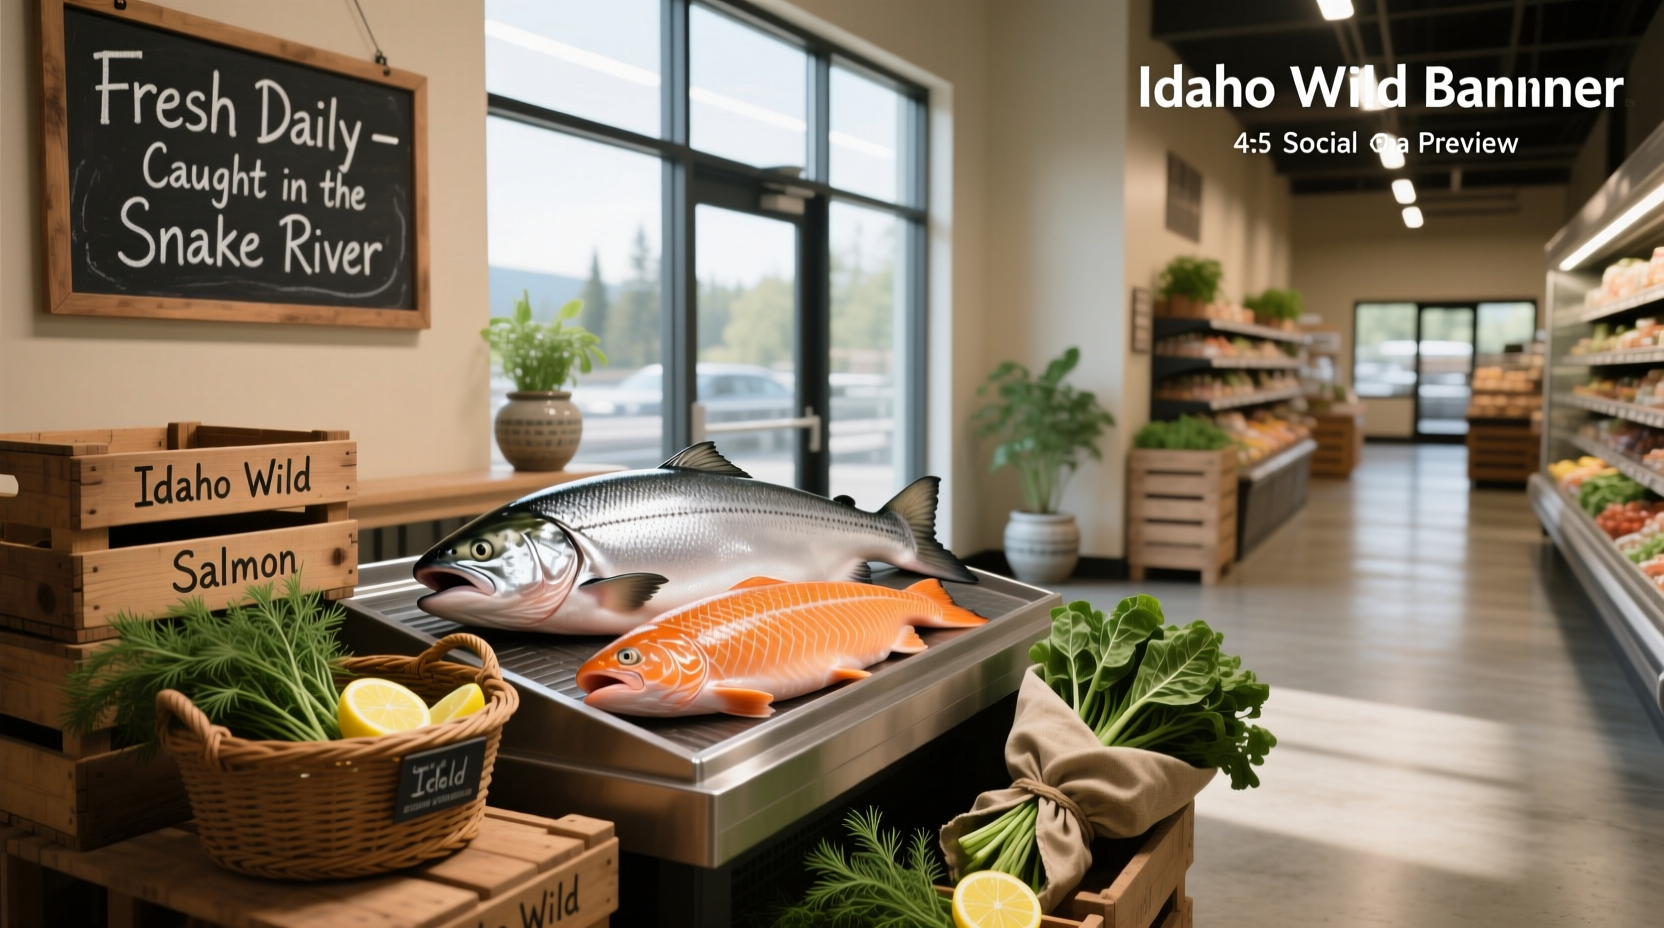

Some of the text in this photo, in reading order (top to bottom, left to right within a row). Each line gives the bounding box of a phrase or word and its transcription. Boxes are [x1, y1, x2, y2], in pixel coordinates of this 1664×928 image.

[93, 50, 236, 138] Fresh
[143, 141, 366, 211] Caught in the
[117, 196, 383, 276] Snake River
[134, 455, 311, 508] Idaho Wild
[172, 546, 298, 593] Salmon
[520, 873, 579, 928] Wild
